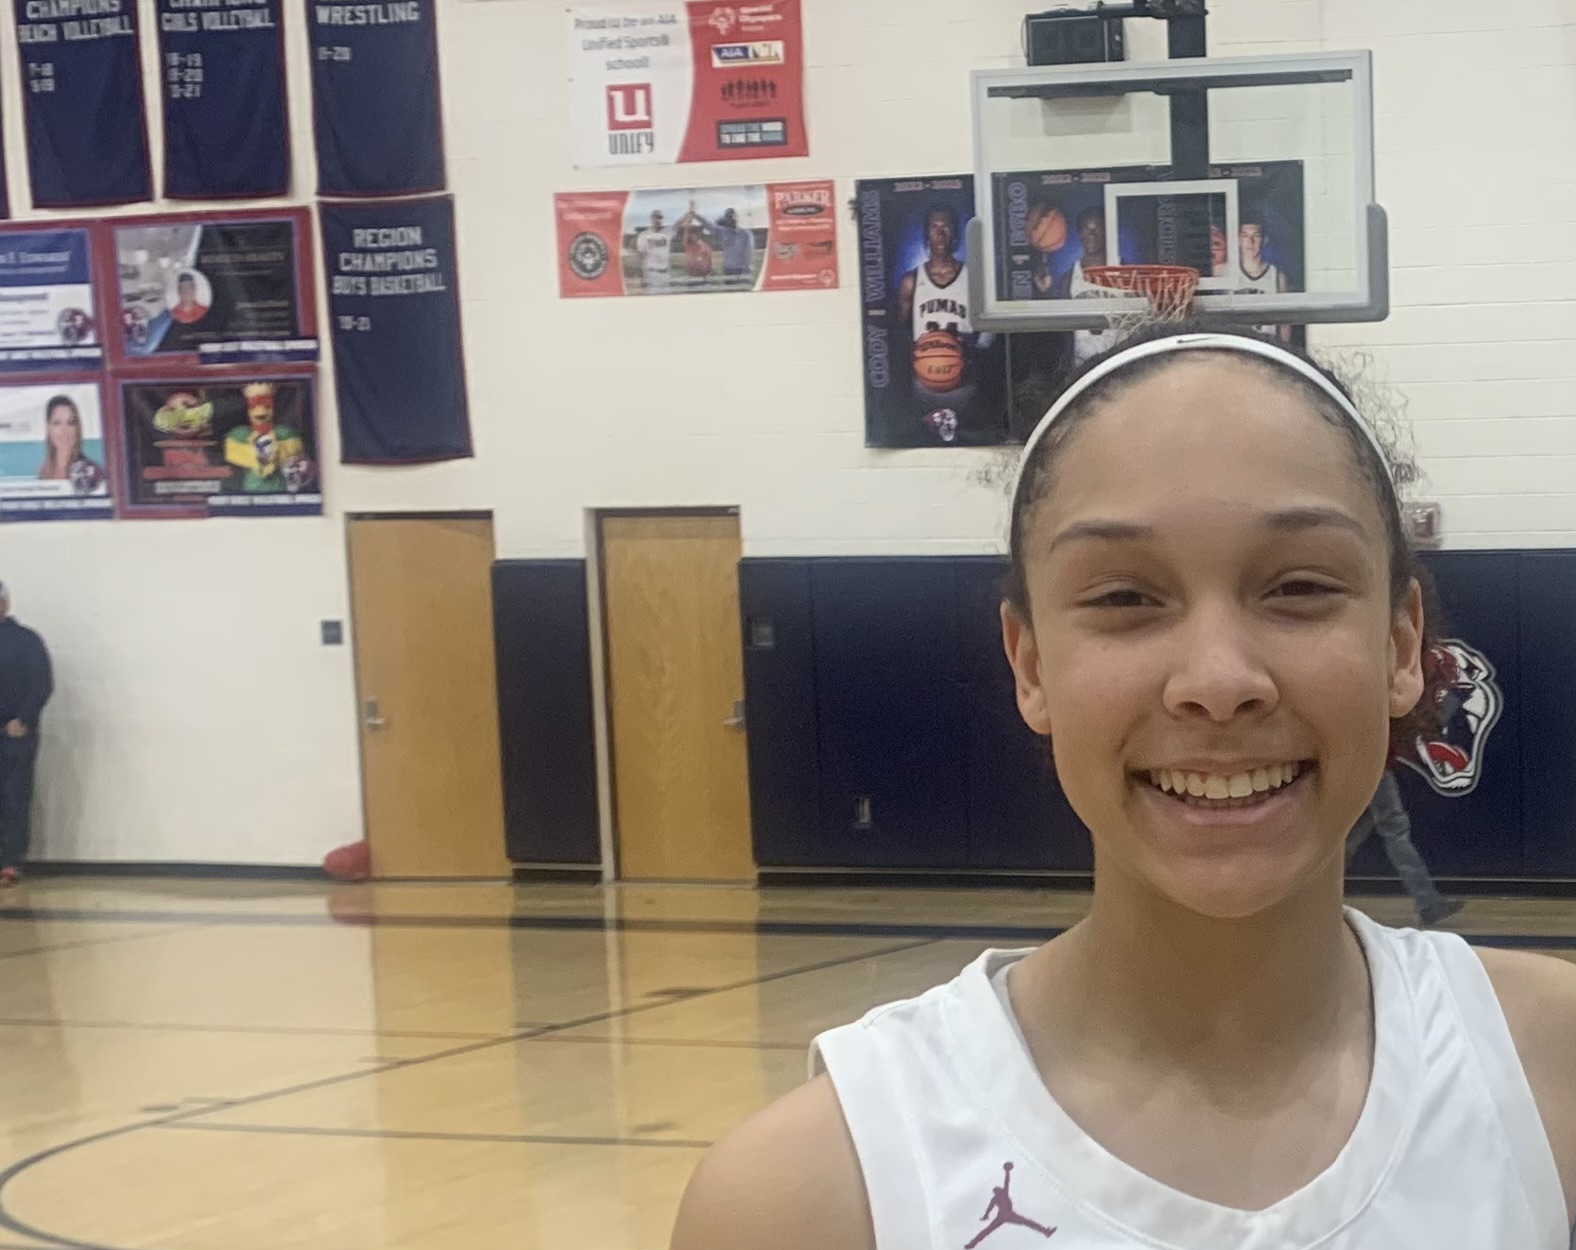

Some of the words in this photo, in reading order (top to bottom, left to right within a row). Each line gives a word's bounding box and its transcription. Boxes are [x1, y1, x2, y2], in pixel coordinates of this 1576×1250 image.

[315, 1, 421, 25] WRESTLING
[352, 226, 422, 249] REGION
[861, 189, 886, 303] WILLIAMS
[339, 248, 439, 272] CHAMPIONS
